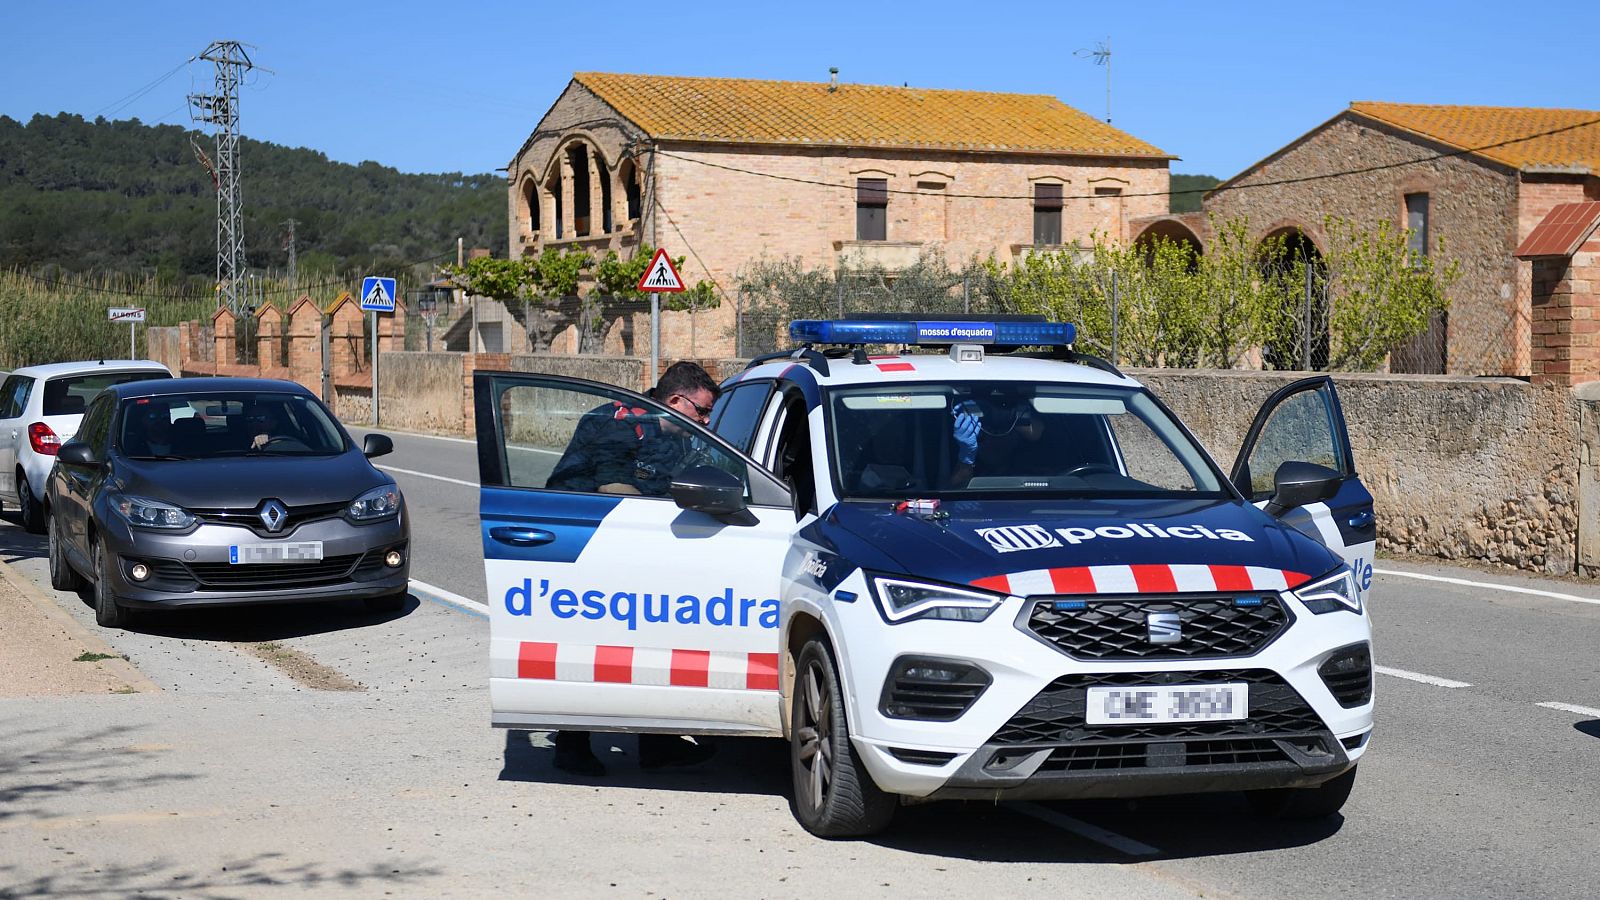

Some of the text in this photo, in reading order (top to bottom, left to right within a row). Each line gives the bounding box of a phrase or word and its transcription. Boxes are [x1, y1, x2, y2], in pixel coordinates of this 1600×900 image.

[951, 327, 993, 337] d'esquadra
[1055, 523, 1255, 544] policia
[504, 577, 780, 631] d'esquadra
